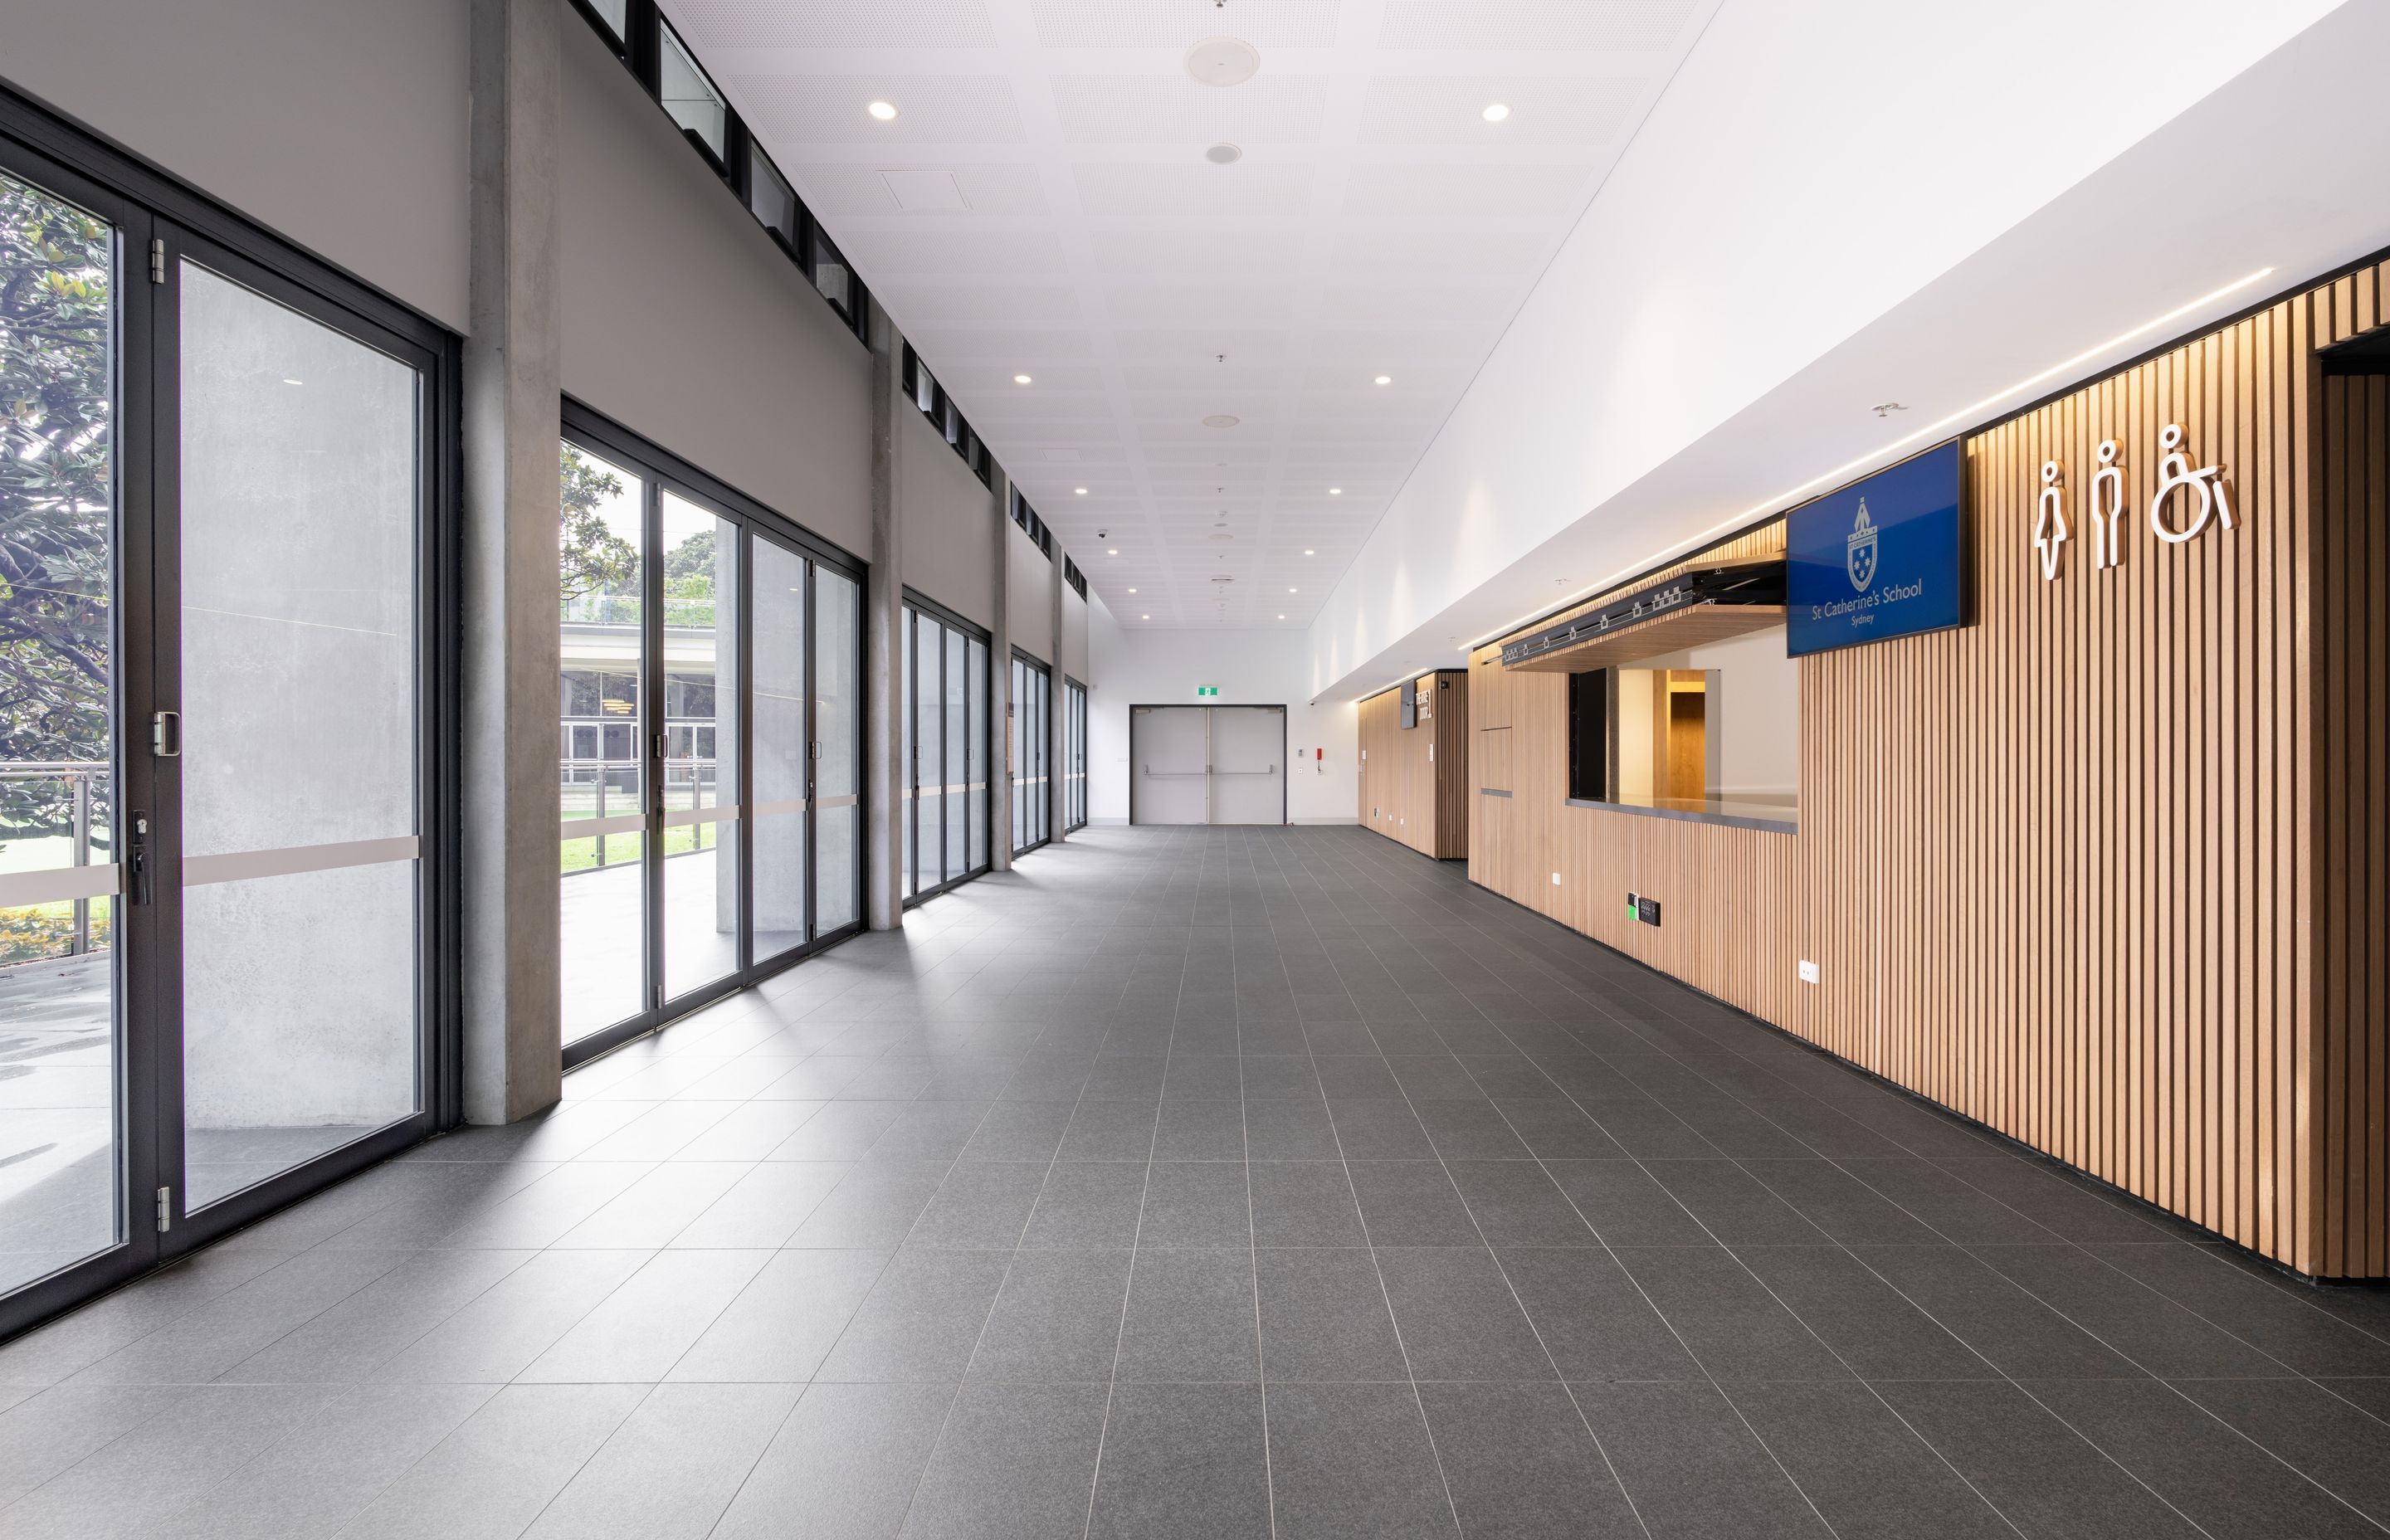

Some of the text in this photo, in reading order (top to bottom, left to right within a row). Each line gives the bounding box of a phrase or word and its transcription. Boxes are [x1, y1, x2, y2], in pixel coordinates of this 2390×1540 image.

[1812, 578, 1921, 620] St Catherine's School
[1851, 615, 1874, 628] Sydney
